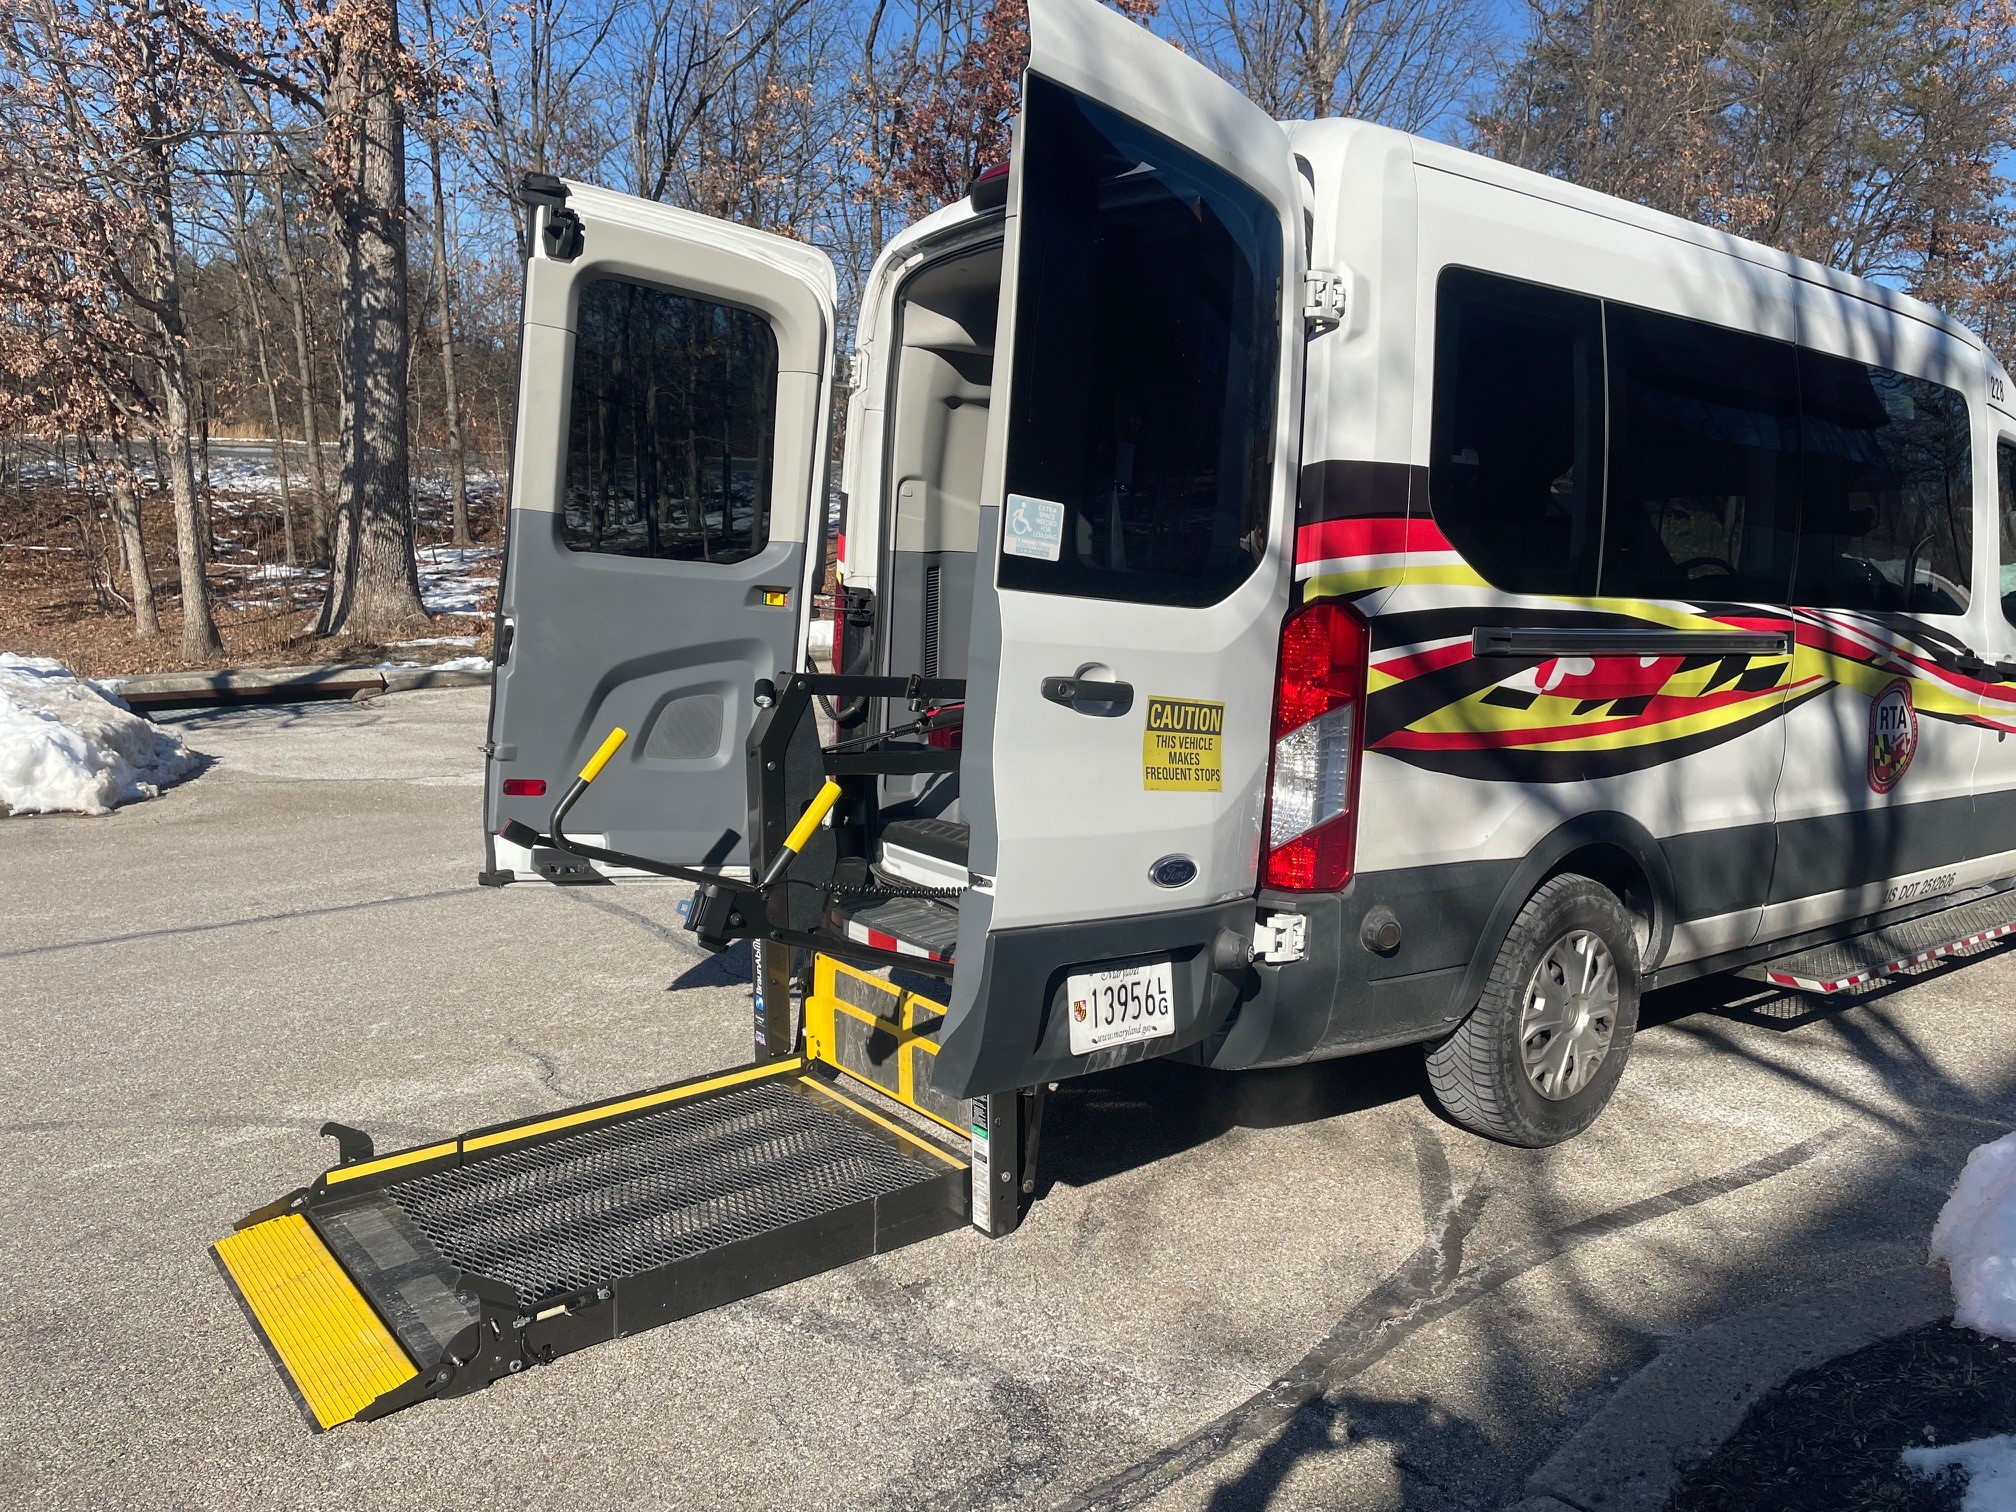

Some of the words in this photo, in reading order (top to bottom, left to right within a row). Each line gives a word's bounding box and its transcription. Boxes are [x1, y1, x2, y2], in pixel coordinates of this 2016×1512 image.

[1038, 504, 1057, 514] EXTRA
[1039, 511, 1056, 521] SPACE
[1036, 517, 1058, 527] NEEDED
[1040, 525, 1052, 534] FOR
[1032, 531, 1058, 541] LOADING
[1150, 703, 1222, 732] CAUTION
[1879, 704, 1907, 731] RTA
[1156, 734, 1176, 749] THIS
[1178, 735, 1213, 751] VEHICLE
[1168, 750, 1200, 766] MAKES
[1145, 766, 1192, 781] FREQUENT
[1194, 768, 1220, 782] STOPS
[1163, 863, 1189, 881] Ford
[1882, 886, 1898, 904] US
[1898, 881, 1921, 901] DOT
[1920, 872, 1957, 895] 2512606
[1091, 978, 1156, 1029] 13956
[1096, 1023, 1152, 1042] www.maryland.gov
